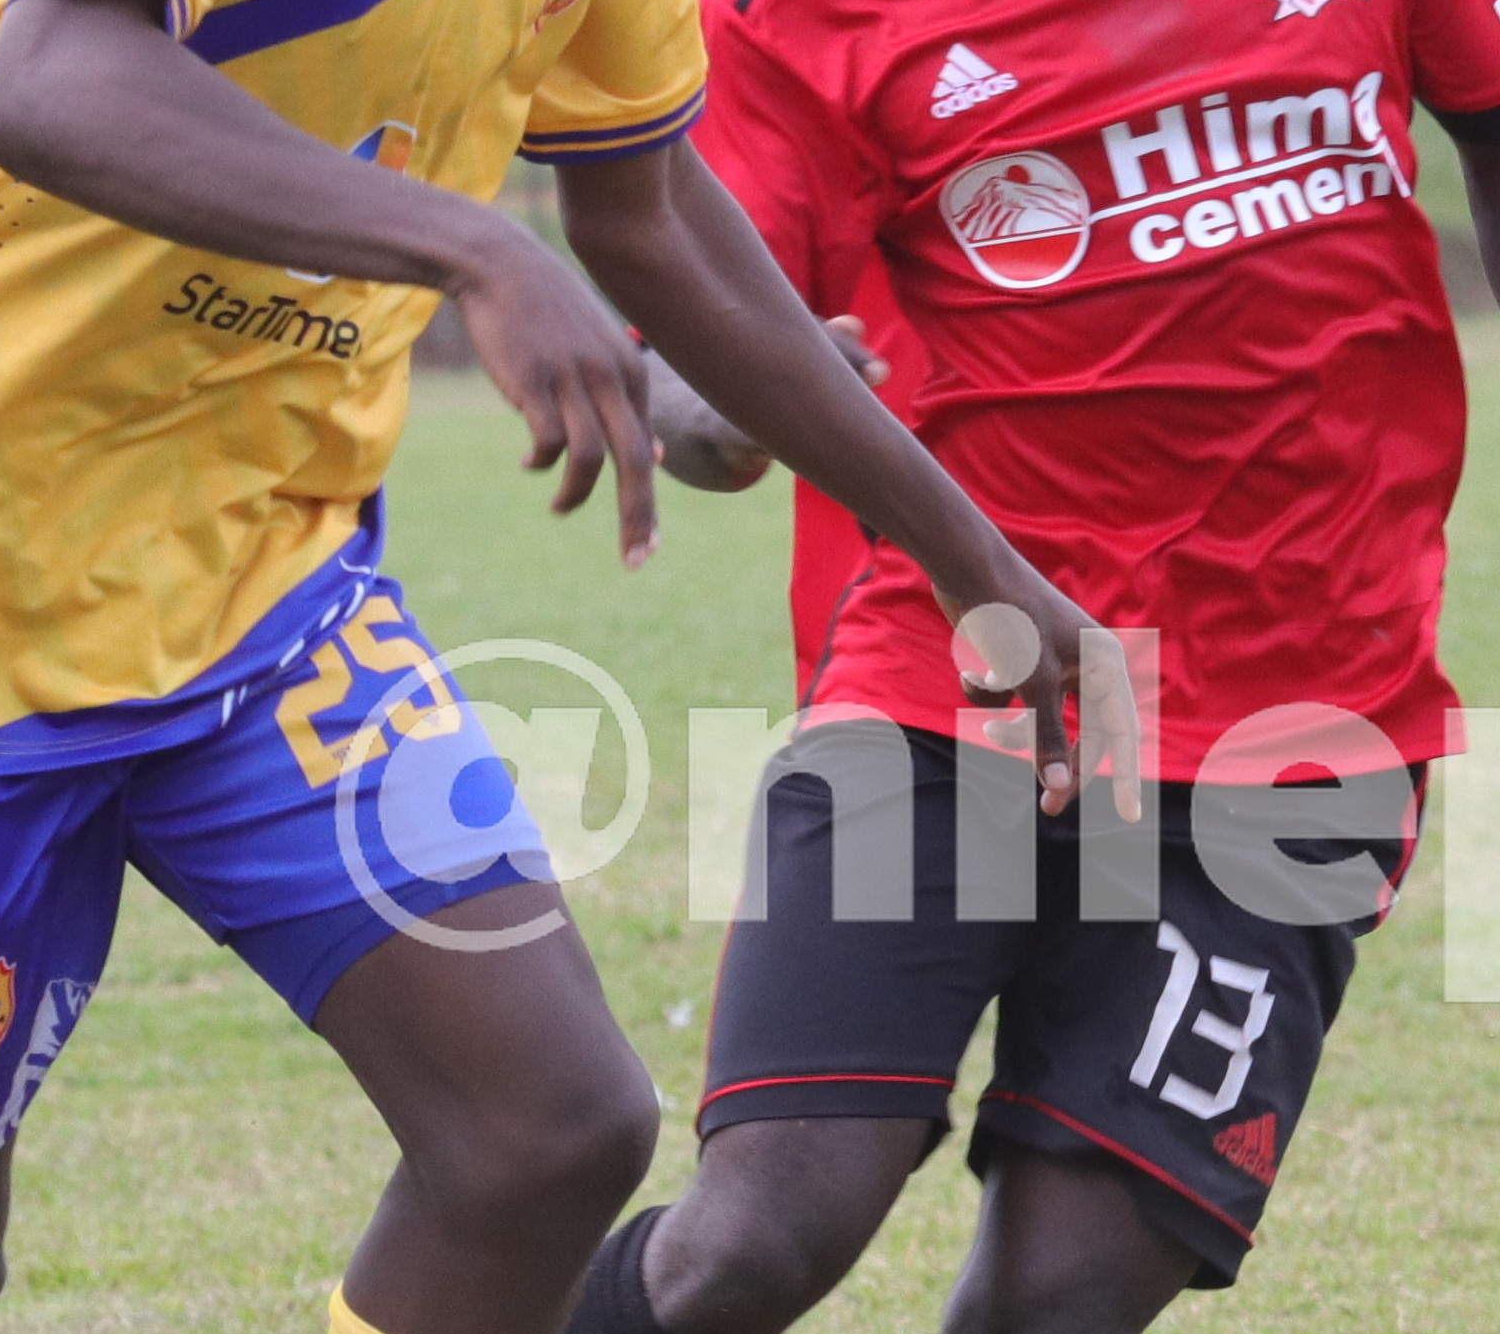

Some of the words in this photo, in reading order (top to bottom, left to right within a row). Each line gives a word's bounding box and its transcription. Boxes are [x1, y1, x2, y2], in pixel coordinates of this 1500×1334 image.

[931, 73, 1019, 120] adidas
[163, 273, 362, 360] StarTime
[275, 595, 463, 790] 25
[1129, 919, 1277, 1121] 13
